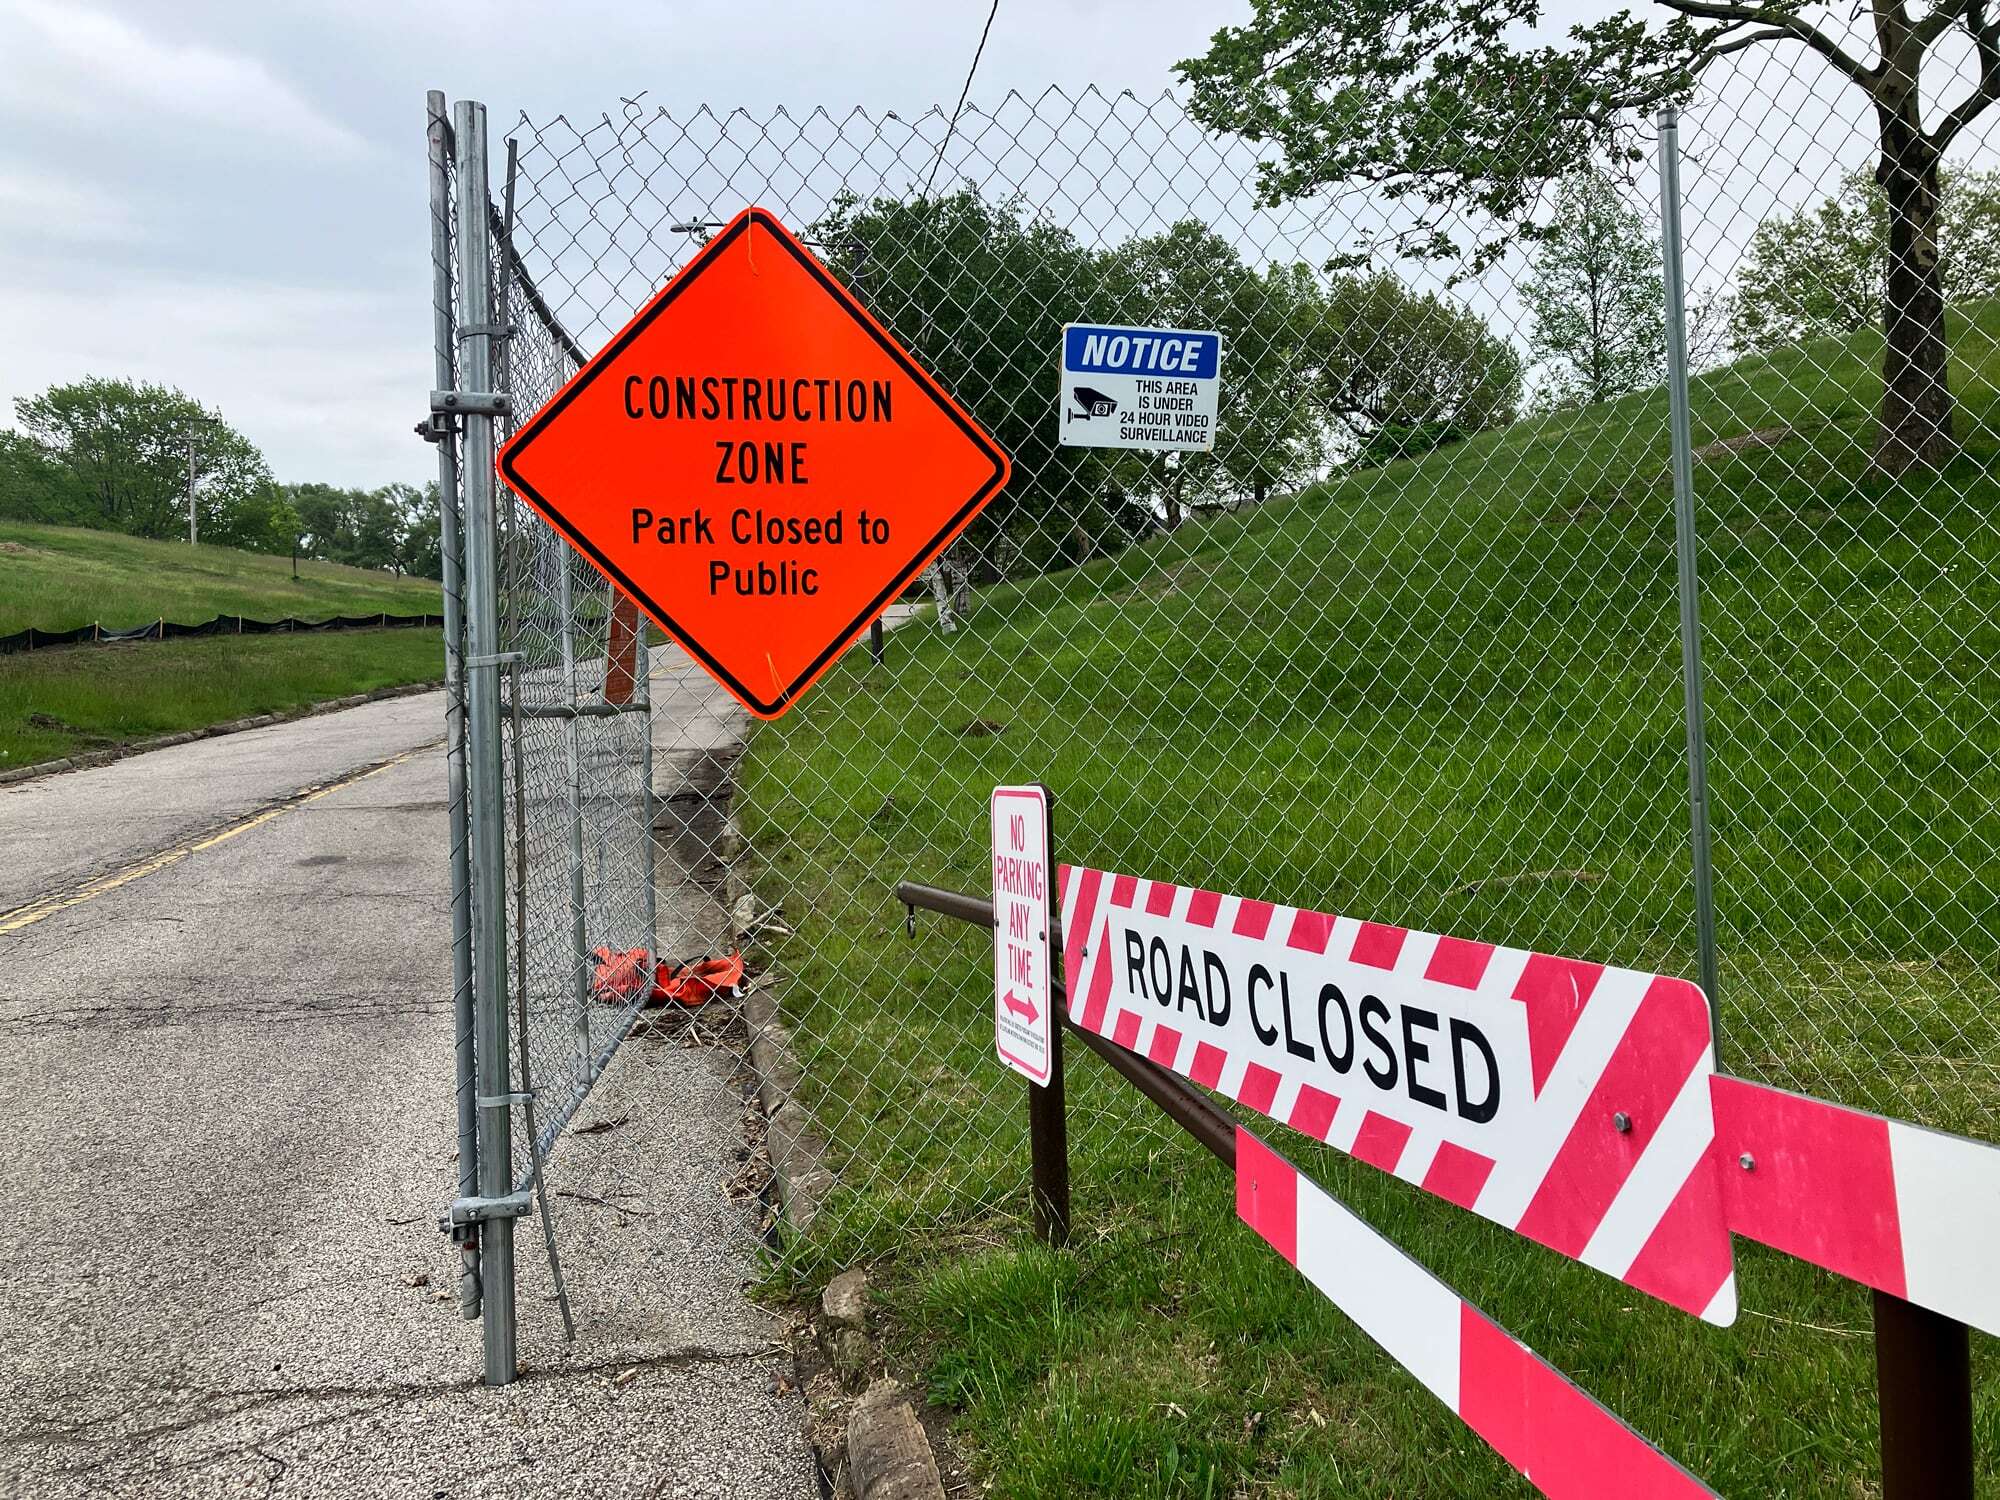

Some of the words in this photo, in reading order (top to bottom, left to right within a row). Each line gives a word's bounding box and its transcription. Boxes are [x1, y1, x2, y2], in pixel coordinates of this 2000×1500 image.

[1081, 335, 1203, 372] NOTICE
[624, 376, 892, 422] CONSTRUCTION
[1136, 380, 1163, 393] THIS
[1166, 382, 1198, 395] AREA
[1139, 396, 1150, 409] IS
[1154, 397, 1193, 411] UNDER
[1120, 412, 1135, 424] 24
[1139, 413, 1171, 426] HOUR
[1175, 415, 1209, 428] VIDEO
[1120, 427, 1207, 443] SURVEILLANCE
[716, 441, 808, 484] ZONE
[632, 508, 715, 544] Park
[731, 508, 842, 544] Closed
[858, 510, 890, 544] to
[710, 560, 819, 596] Public
[1010, 814, 1025, 852] NO
[996, 856, 1042, 901] PARKING
[1009, 901, 1029, 943] ANY
[1007, 943, 1033, 989] TIME
[1125, 928, 1232, 1027] ROAD
[1247, 963, 1501, 1125] CLOSED
